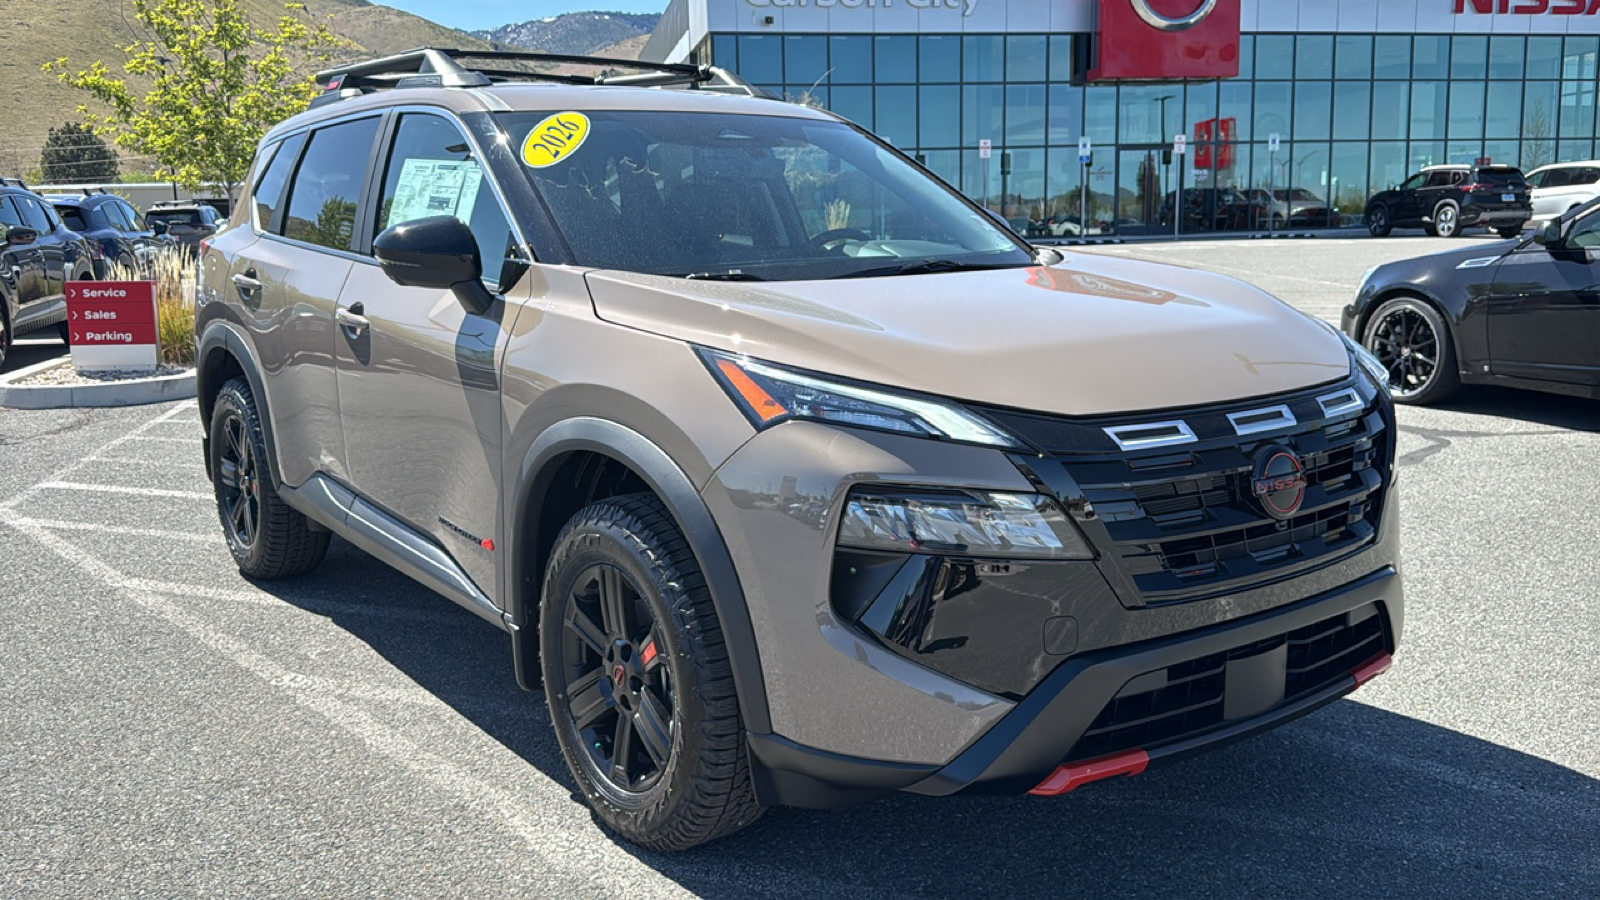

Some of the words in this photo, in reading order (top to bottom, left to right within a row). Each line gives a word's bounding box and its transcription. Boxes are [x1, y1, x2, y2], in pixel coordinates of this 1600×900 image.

[532, 116, 580, 159] 2026
[82, 288, 126, 298] Service
[84, 310, 117, 320] Sales
[86, 331, 132, 342] Parking
